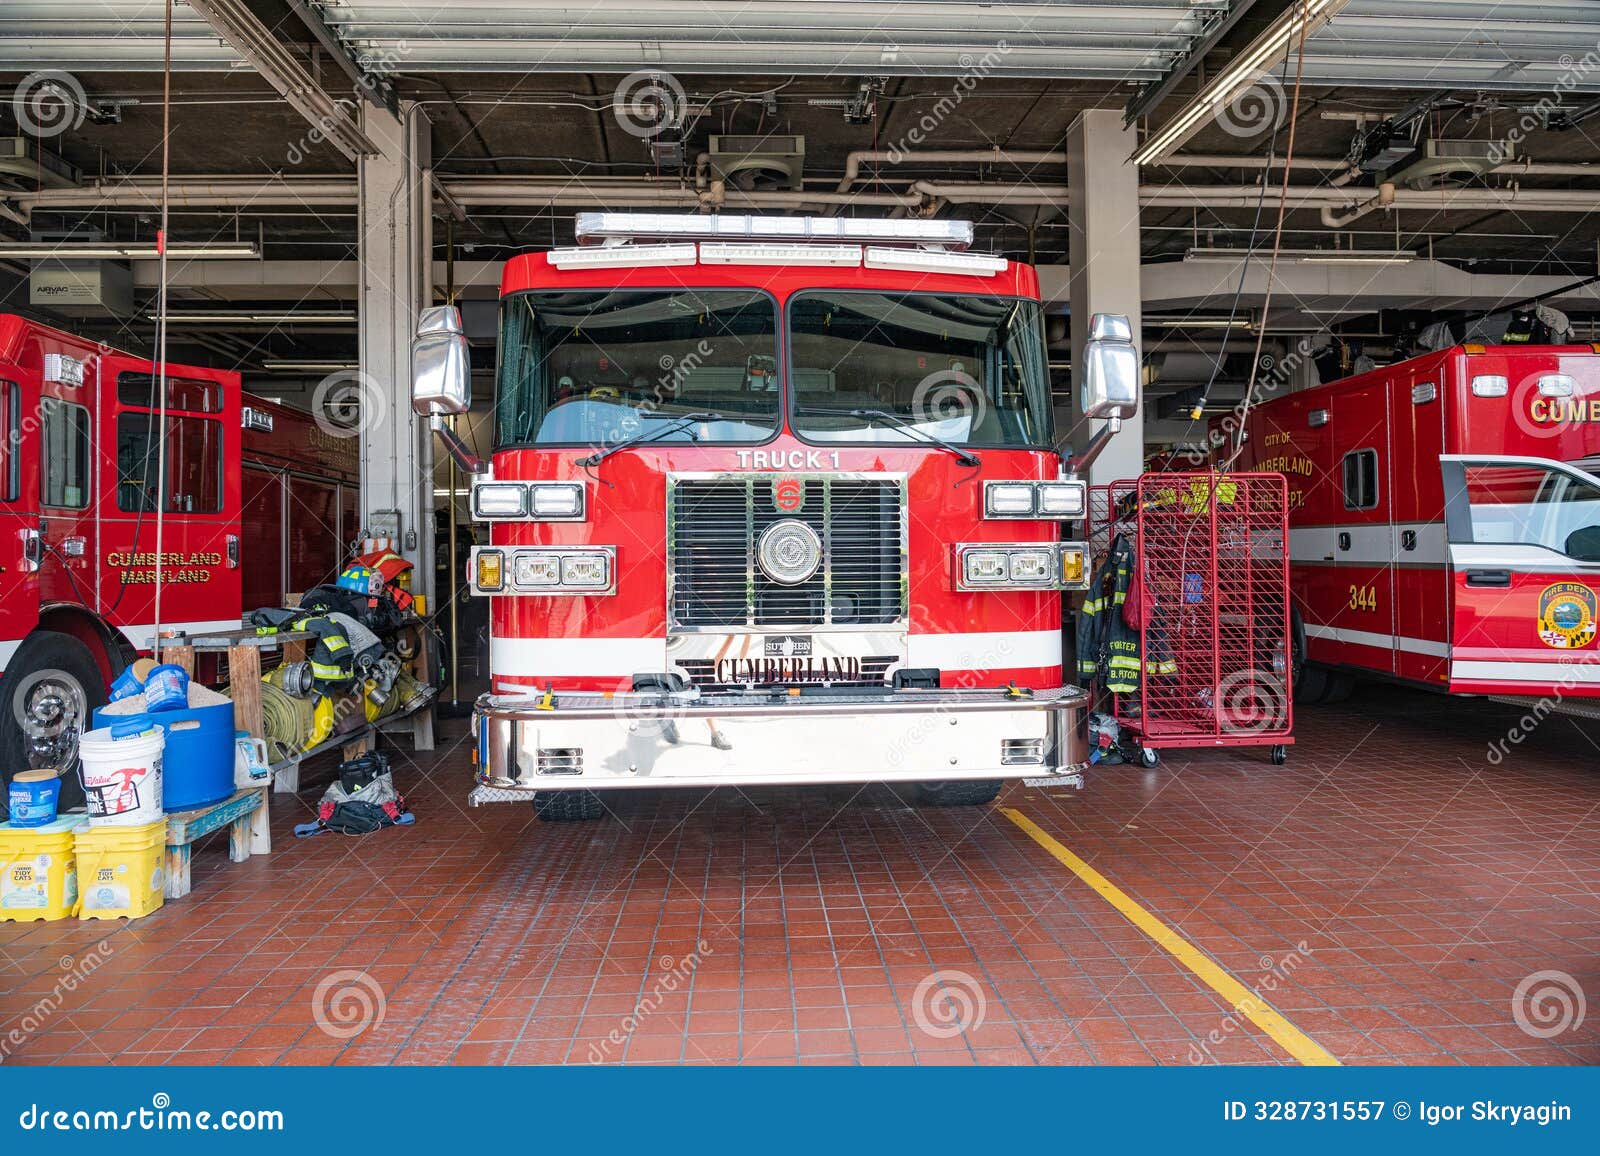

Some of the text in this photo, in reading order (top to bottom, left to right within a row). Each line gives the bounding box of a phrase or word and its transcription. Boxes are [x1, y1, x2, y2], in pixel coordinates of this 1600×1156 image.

[1264, 431, 1291, 447] CITY OF
[736, 450, 840, 469] TRUCK 1
[107, 551, 222, 567] CUMBERLAND
[120, 569, 211, 584] MARYLAND
[1349, 584, 1377, 612] 344
[765, 642, 811, 651] SUTHEN
[717, 656, 860, 684] CUMBERLAND
